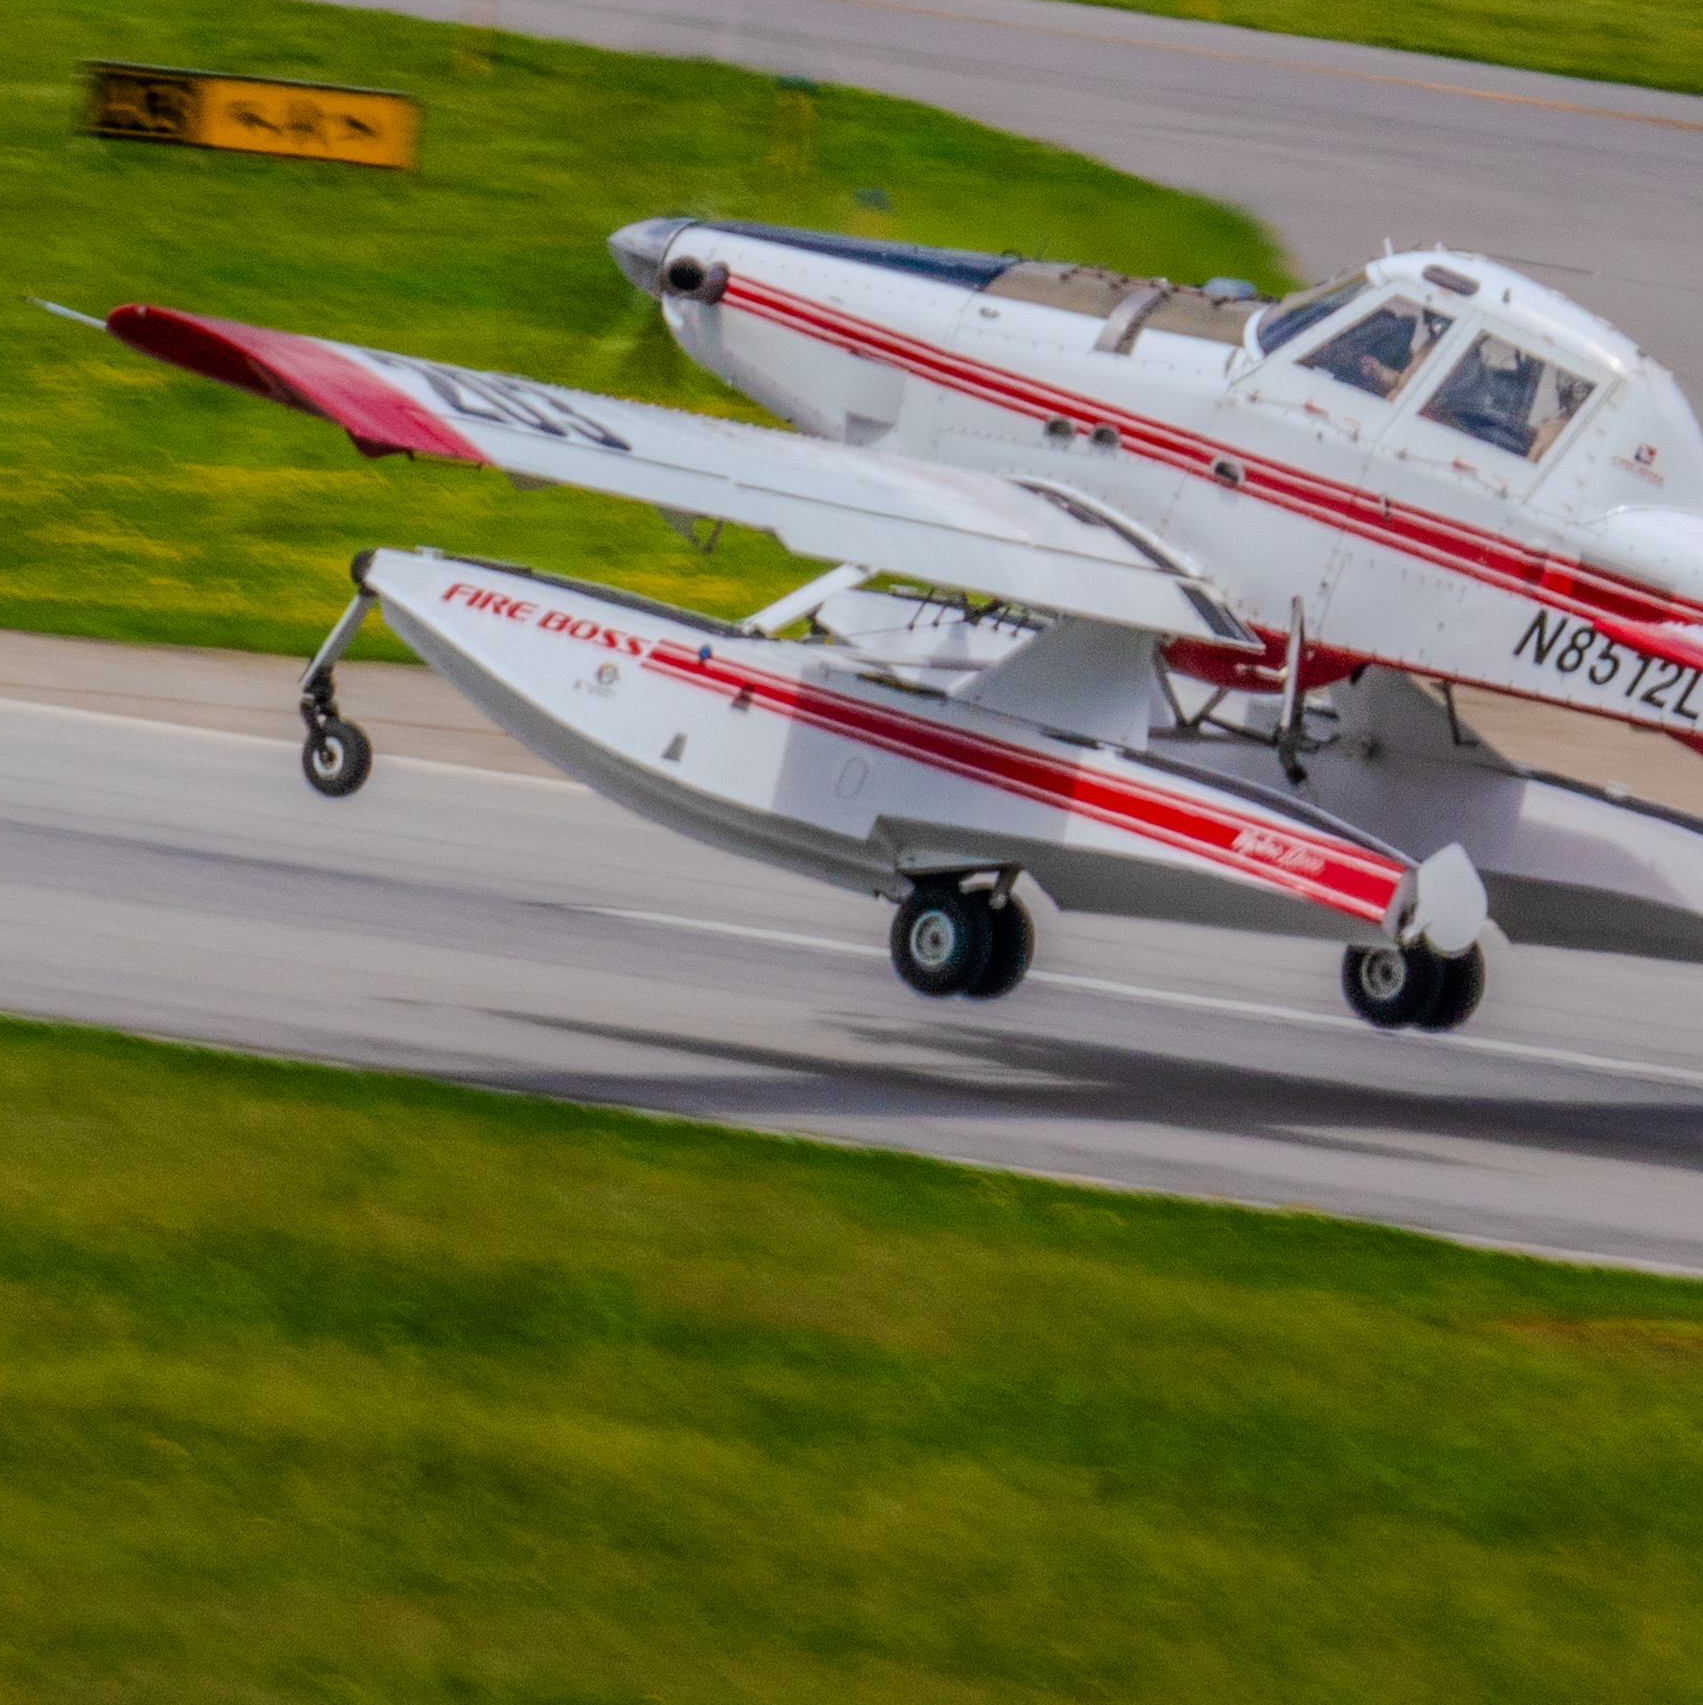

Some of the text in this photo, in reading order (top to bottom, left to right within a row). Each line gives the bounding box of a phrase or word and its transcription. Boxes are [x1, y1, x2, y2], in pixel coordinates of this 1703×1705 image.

[442, 583, 652, 655] FIRE BOSS
[1513, 609, 1703, 720] N8512L
